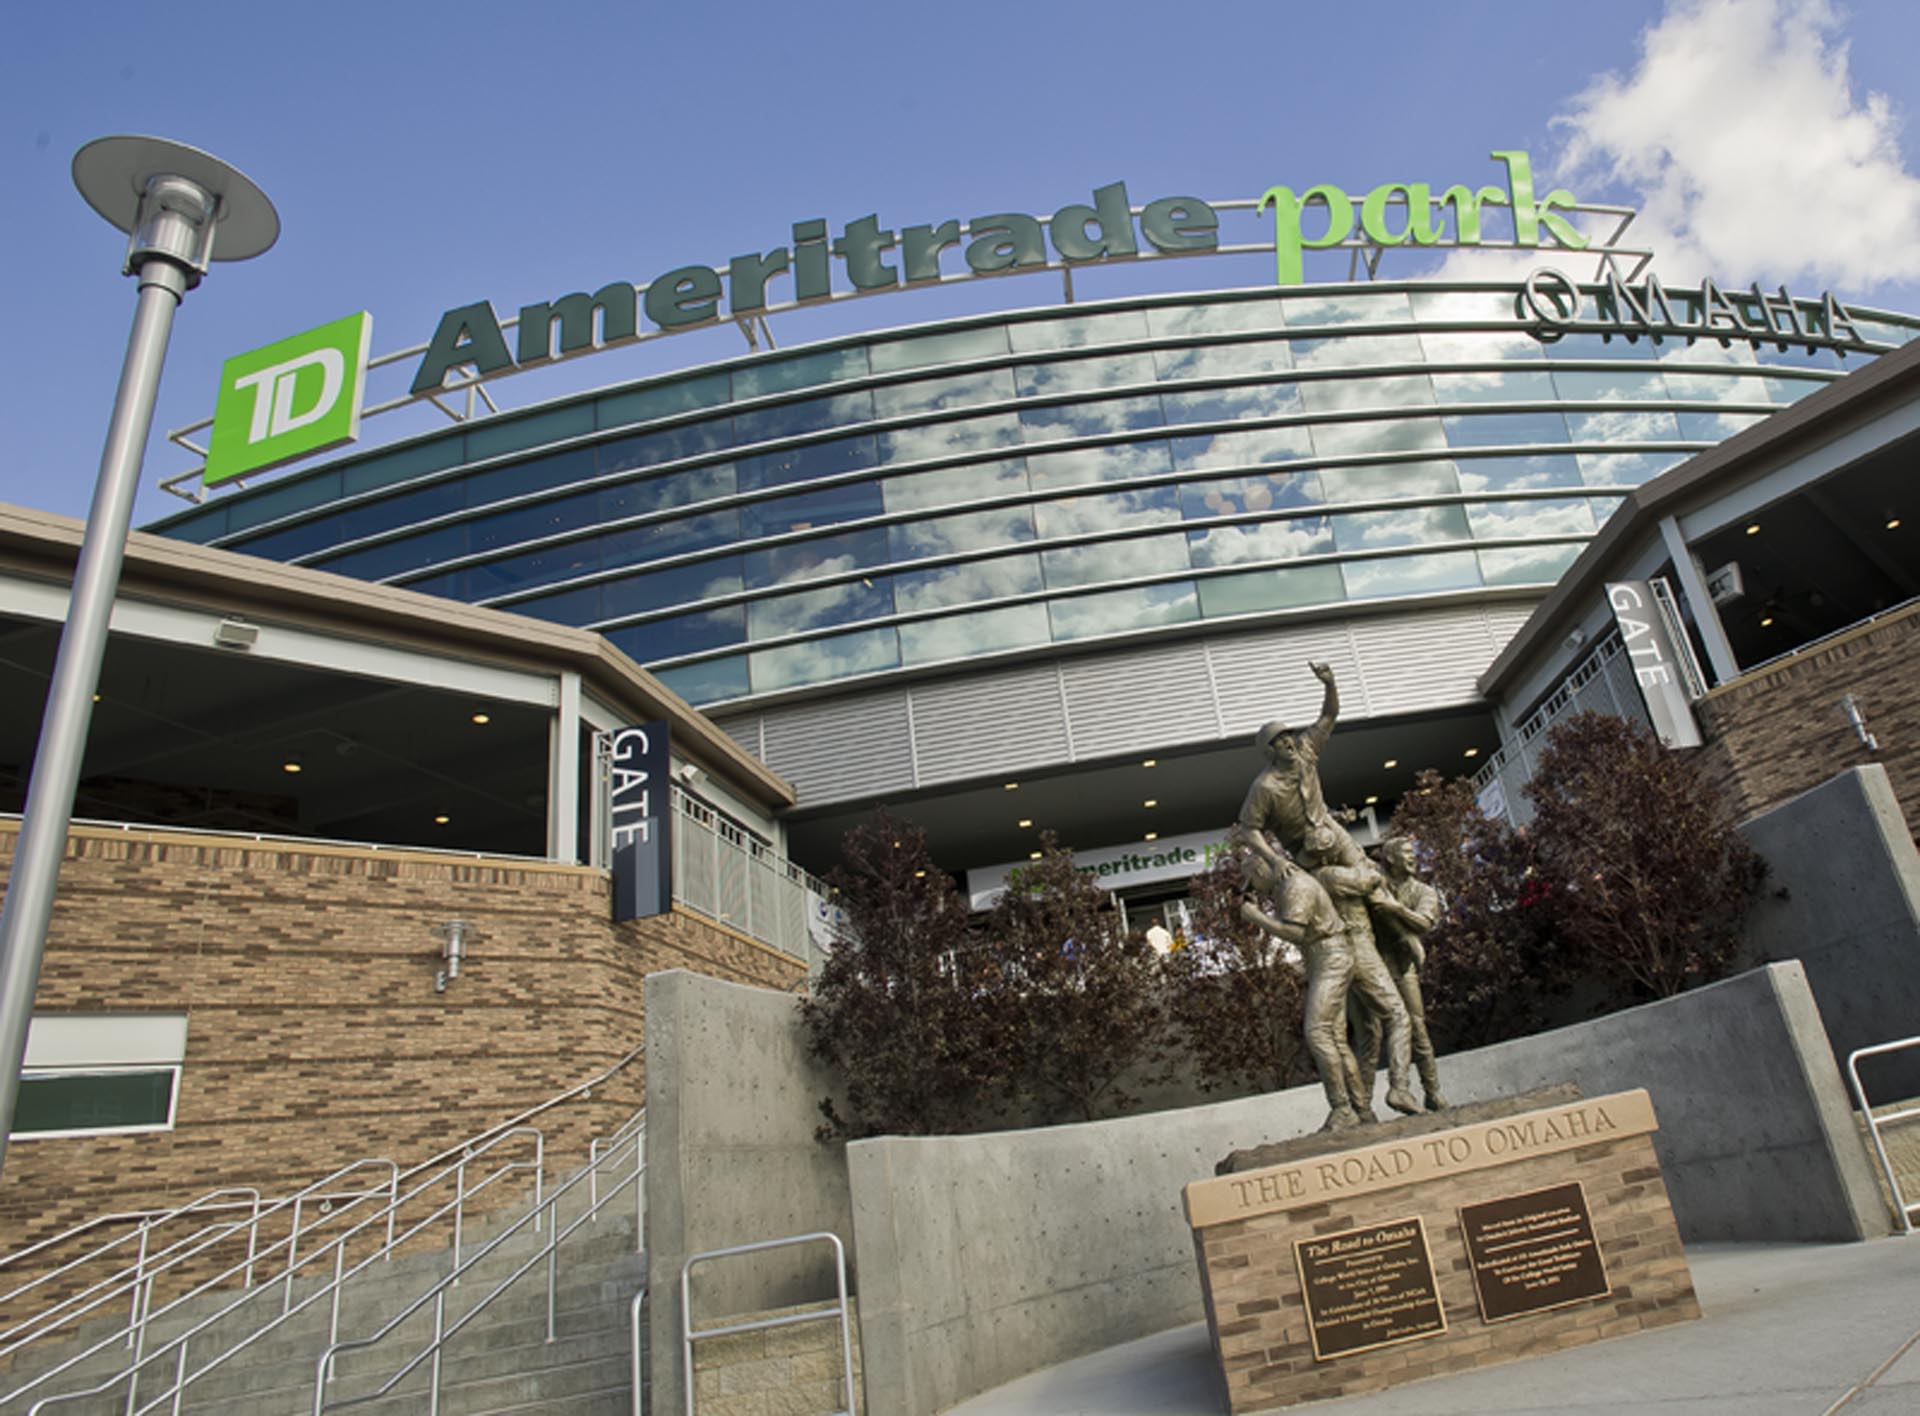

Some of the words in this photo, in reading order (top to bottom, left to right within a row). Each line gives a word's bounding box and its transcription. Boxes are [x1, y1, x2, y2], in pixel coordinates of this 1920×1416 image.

[234, 346, 345, 445] TD
[409, 180, 1219, 397] Ameritrade
[1256, 149, 1592, 286] park
[1523, 267, 1866, 345] OMAHA
[1608, 583, 1670, 689] GATE
[611, 728, 650, 849] GATE
[1231, 1169, 1306, 1208] THE
[1319, 1147, 1415, 1192] ROAD
[1422, 1134, 1473, 1169] TO
[1484, 1106, 1617, 1156] OMAHA
